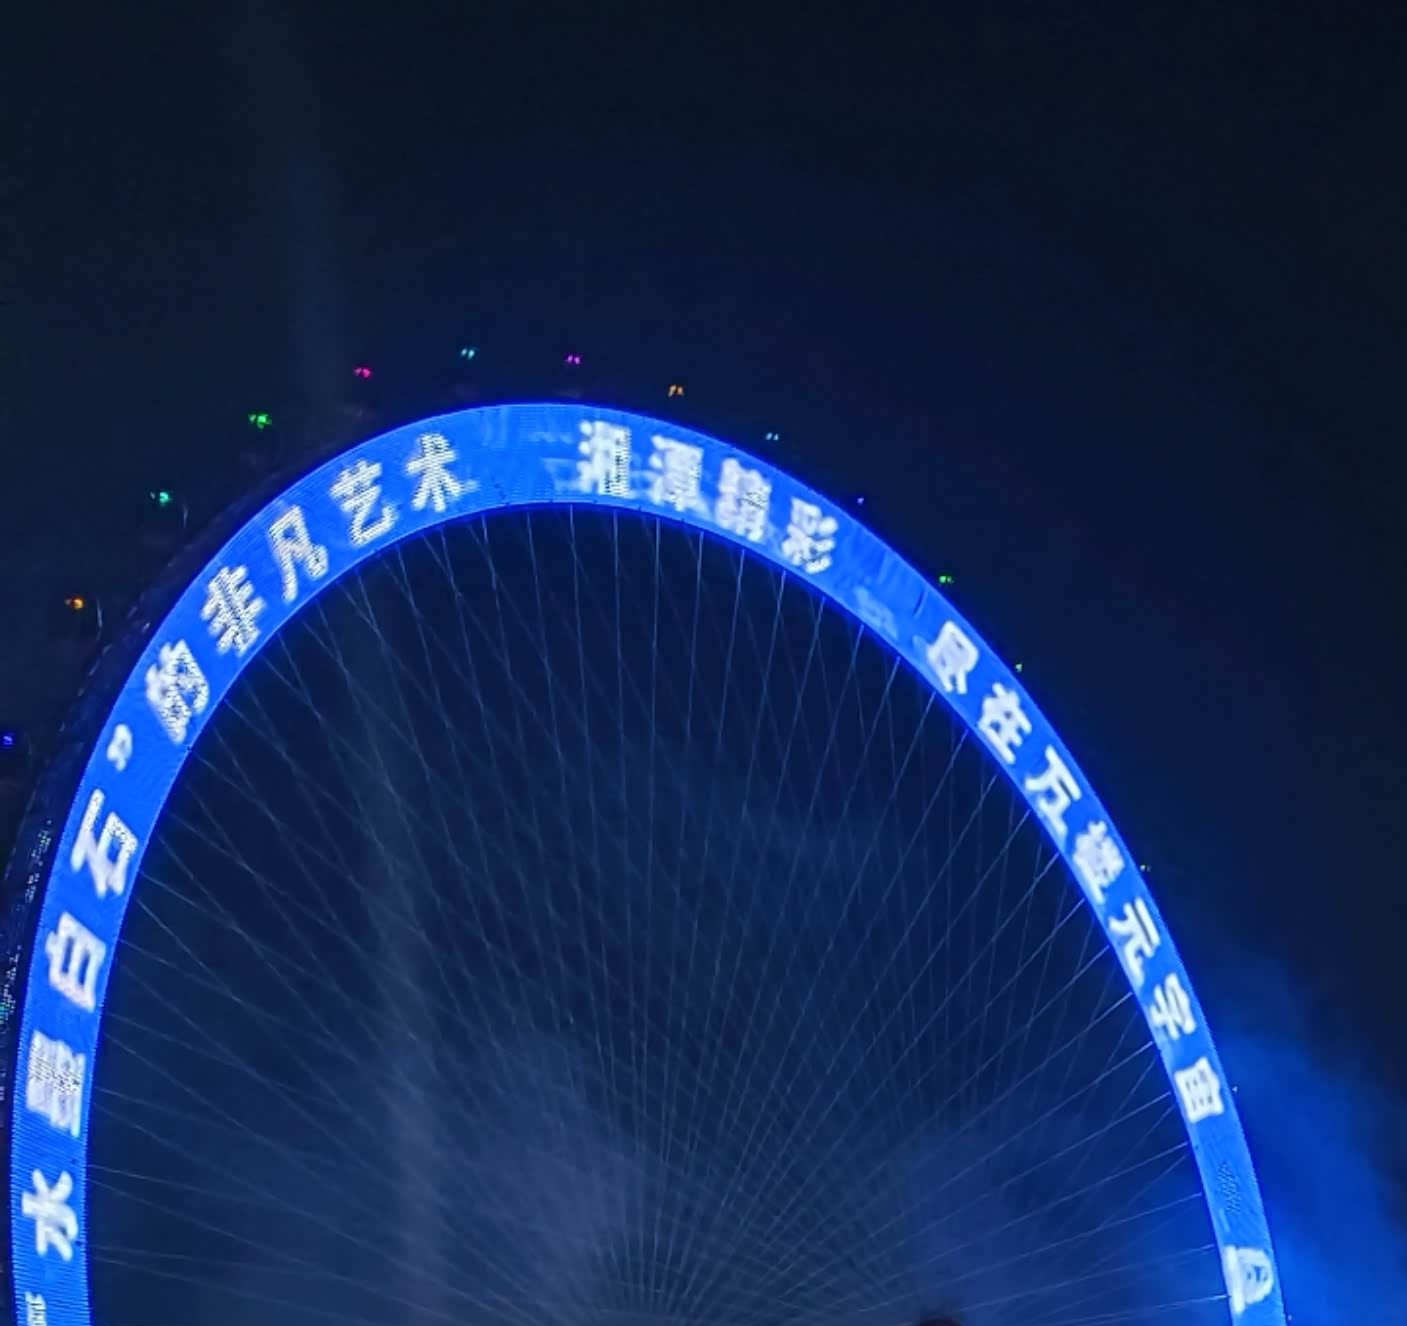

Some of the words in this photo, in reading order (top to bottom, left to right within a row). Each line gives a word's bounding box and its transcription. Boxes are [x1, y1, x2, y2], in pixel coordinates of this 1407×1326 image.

[577, 420, 838, 573] 湘潭精彩
[926, 620, 1223, 1122] 尽在万楼元宇宙
